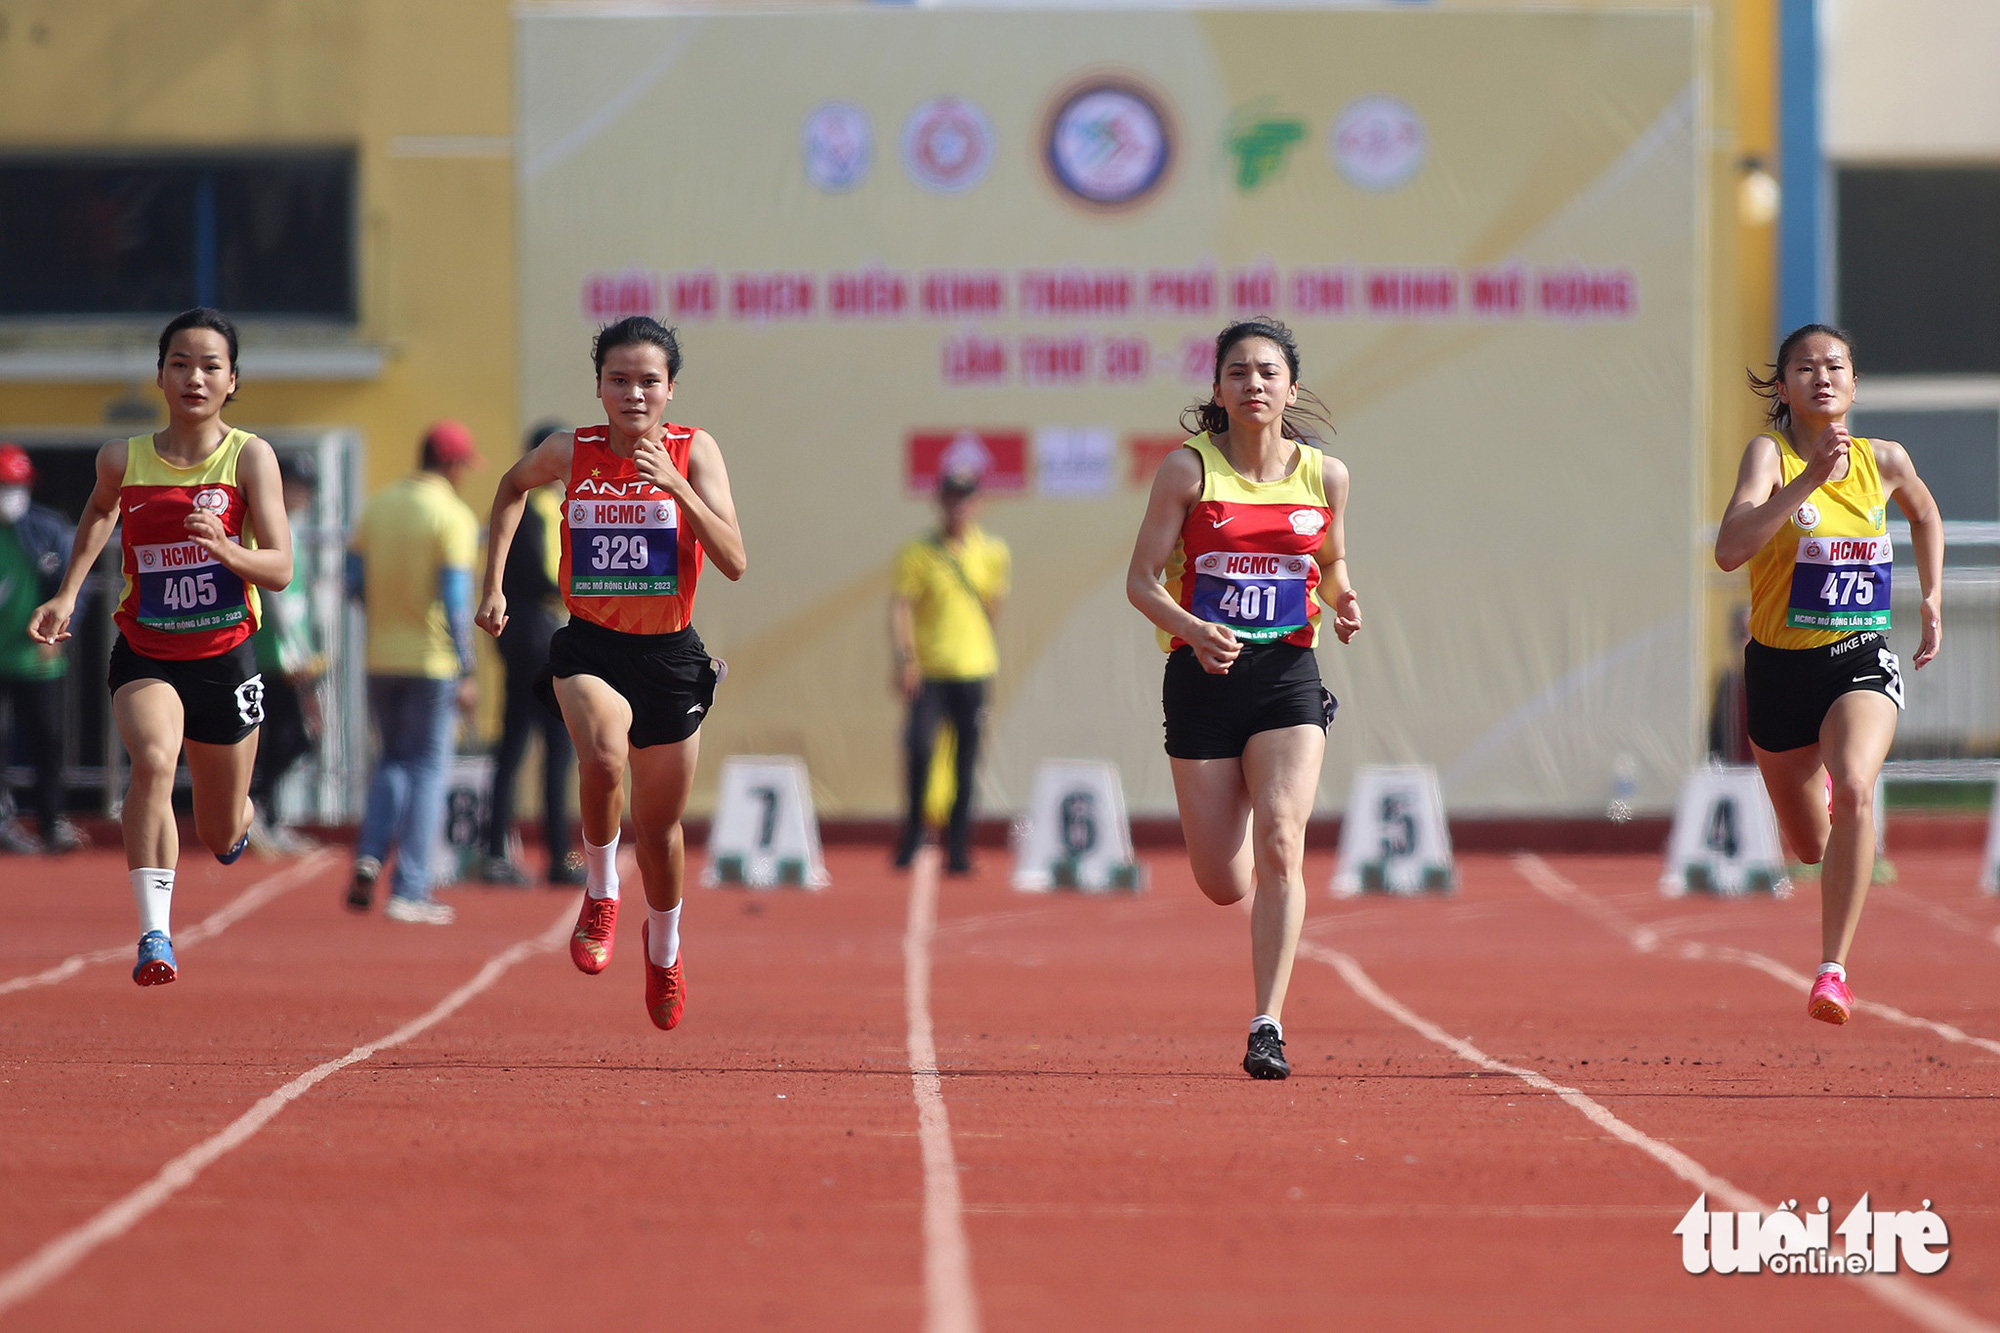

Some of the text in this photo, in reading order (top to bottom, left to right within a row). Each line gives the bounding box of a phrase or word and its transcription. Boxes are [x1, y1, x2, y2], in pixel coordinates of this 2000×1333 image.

[594, 504, 646, 524] HCMC
[161, 545, 209, 567] HCMC
[591, 535, 649, 570] 329
[1225, 556, 1280, 575] HCMC
[1829, 541, 1878, 561] HCMC
[163, 572, 218, 610] 405
[575, 582, 591, 590] HCMC
[638, 582, 648, 590] 30
[654, 582, 671, 590] 2023
[1219, 585, 1277, 621] 401
[1819, 571, 1876, 606] 475
[225, 610, 243, 621] 2023
[1794, 614, 1816, 624] HCMC
[1830, 636, 1860, 657] NIKE
[446, 787, 479, 845] 8
[748, 786, 779, 848] 7
[1059, 792, 1096, 853] 6
[1380, 795, 1417, 857] 5
[1705, 797, 1739, 858] 4
